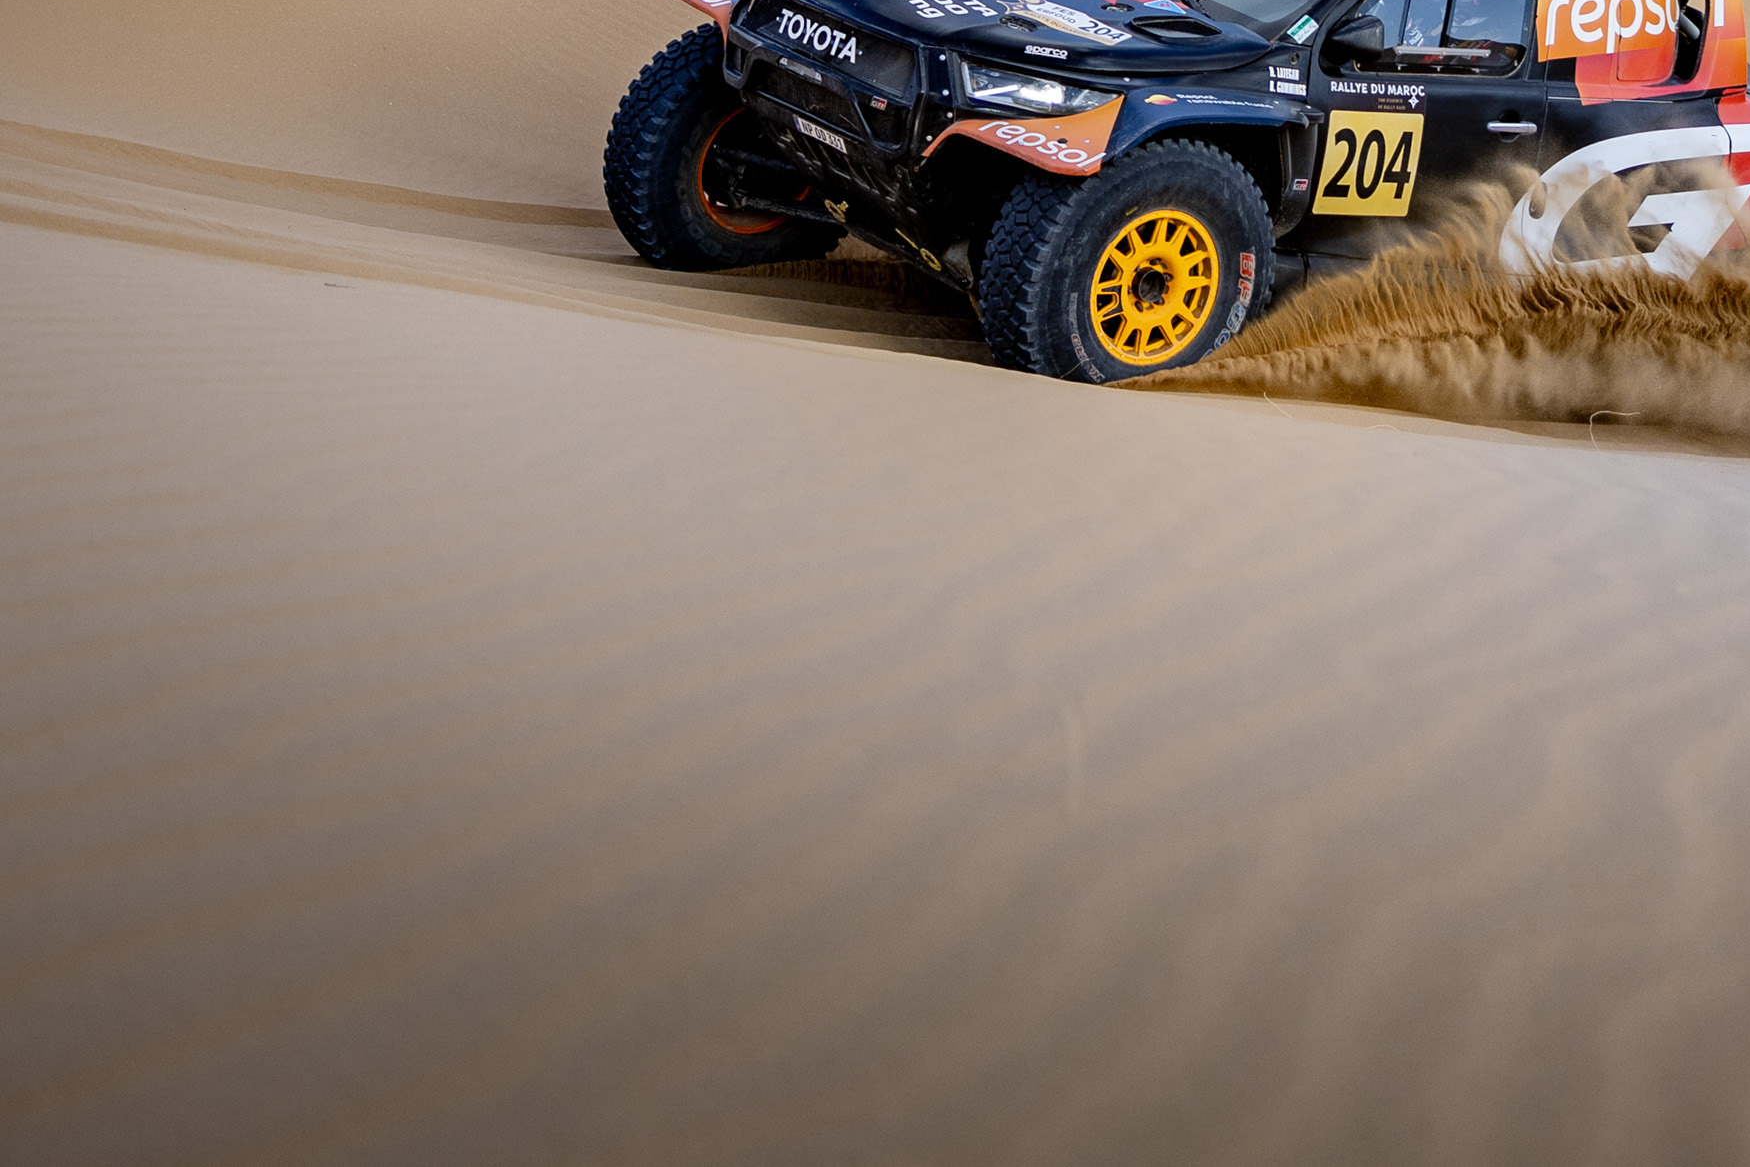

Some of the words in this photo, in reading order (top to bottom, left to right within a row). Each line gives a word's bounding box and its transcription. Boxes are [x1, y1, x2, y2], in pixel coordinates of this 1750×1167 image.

[1036, 7, 1076, 24] ERFOUD
[1052, 6, 1076, 16] FES
[778, 8, 857, 64] TOYOTA
[1078, 20, 1125, 40] 204
[1024, 44, 1068, 60] sparco
[1330, 81, 1368, 94] RALLYE
[1370, 83, 1385, 95] DU
[1387, 84, 1426, 97] MAROC
[827, 132, 844, 151] 331
[978, 120, 1106, 168] repsol
[1322, 128, 1414, 200] 204
